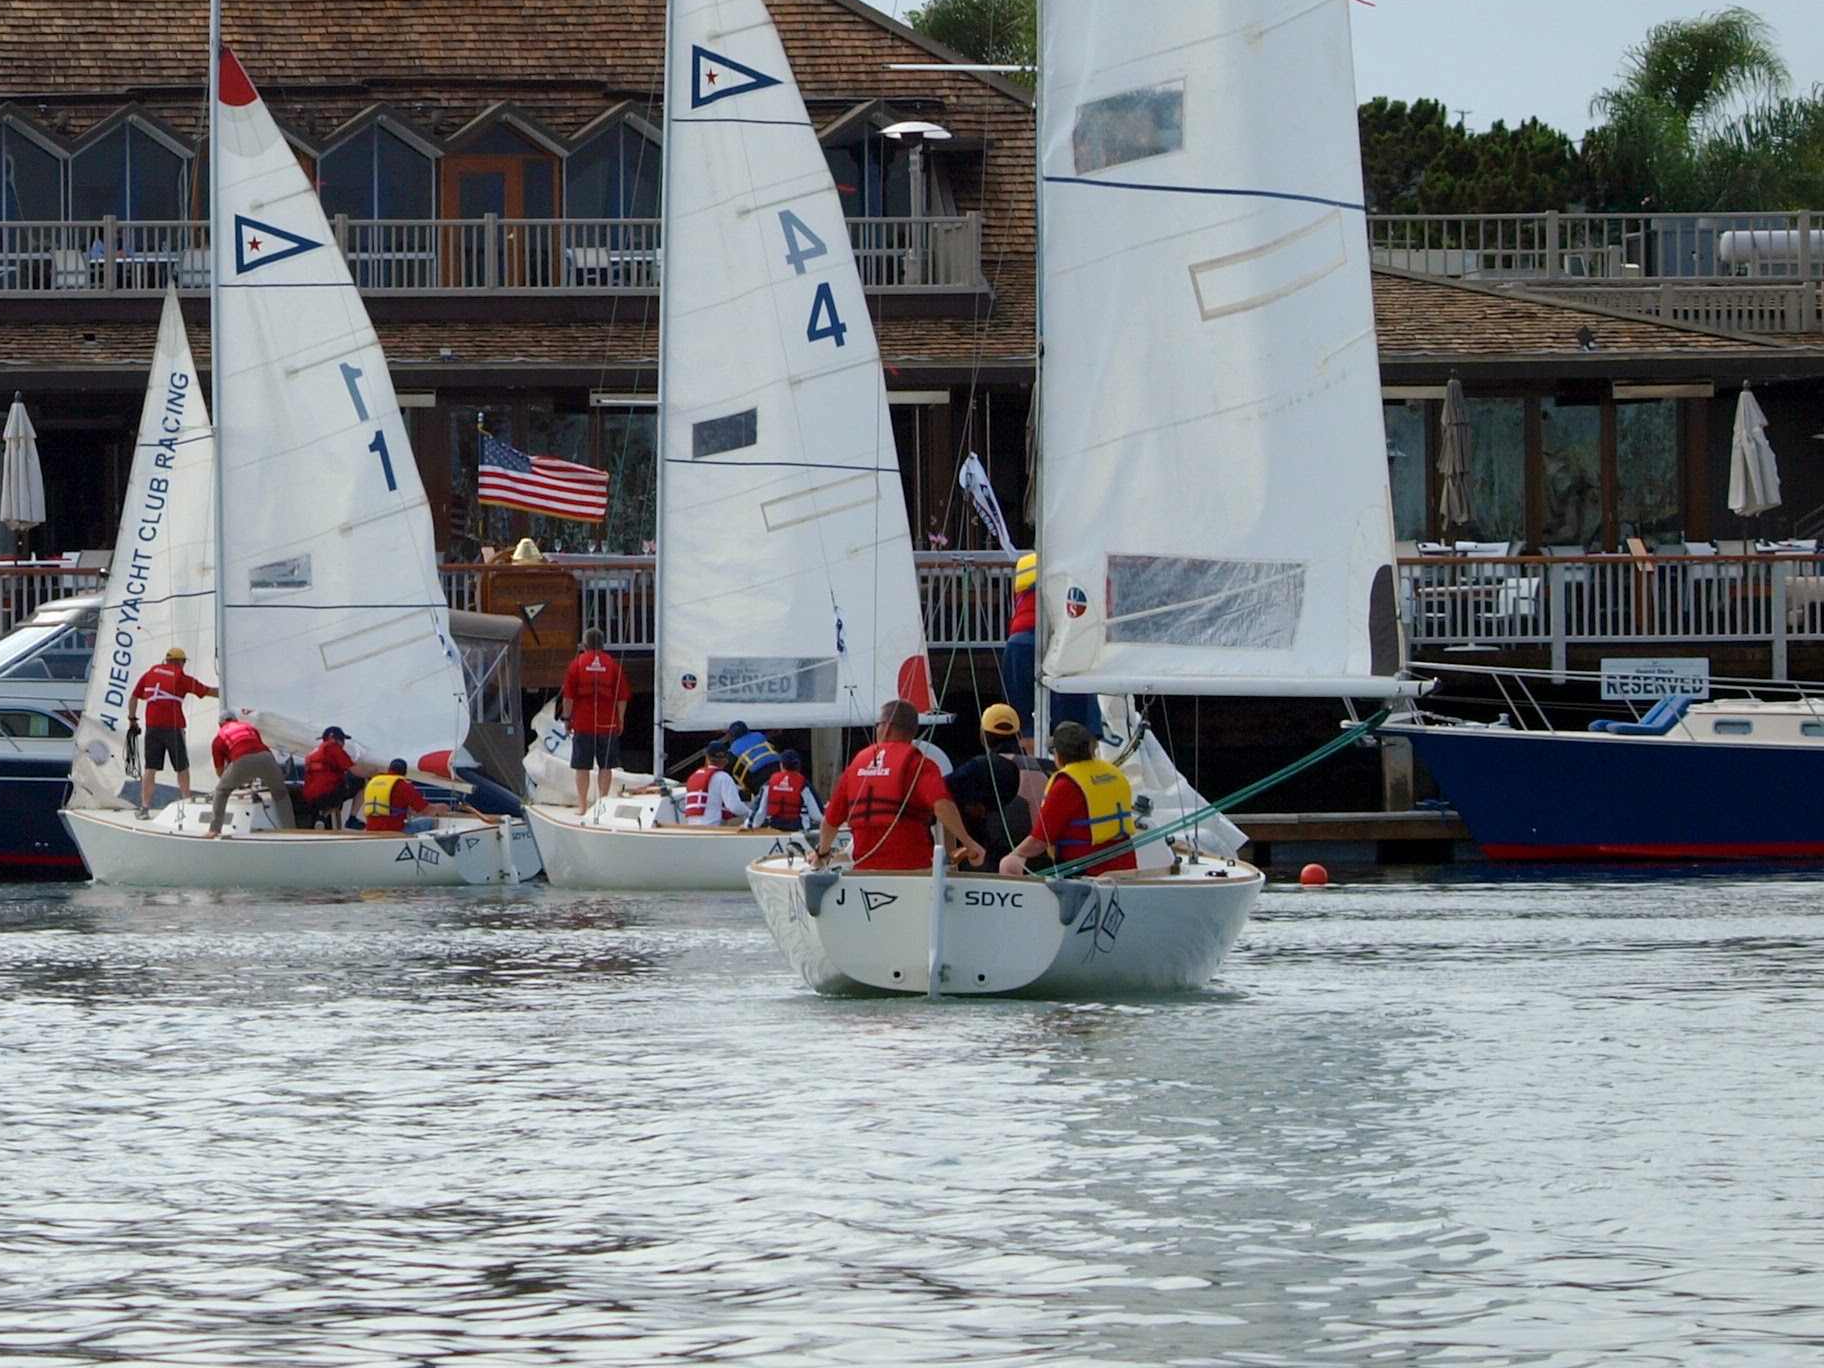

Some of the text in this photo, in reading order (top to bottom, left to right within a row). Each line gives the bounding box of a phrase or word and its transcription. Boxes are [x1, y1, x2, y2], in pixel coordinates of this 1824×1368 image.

[807, 282, 847, 347] 4
[155, 372, 189, 470] RACING
[368, 429, 397, 492] 1
[138, 477, 169, 542] CLUB
[118, 547, 153, 624] YACHT
[104, 630, 133, 708] DIEGO
[1606, 675, 1704, 694] RESERVED
[836, 888, 846, 906] J
[965, 890, 1024, 909] SDYC
